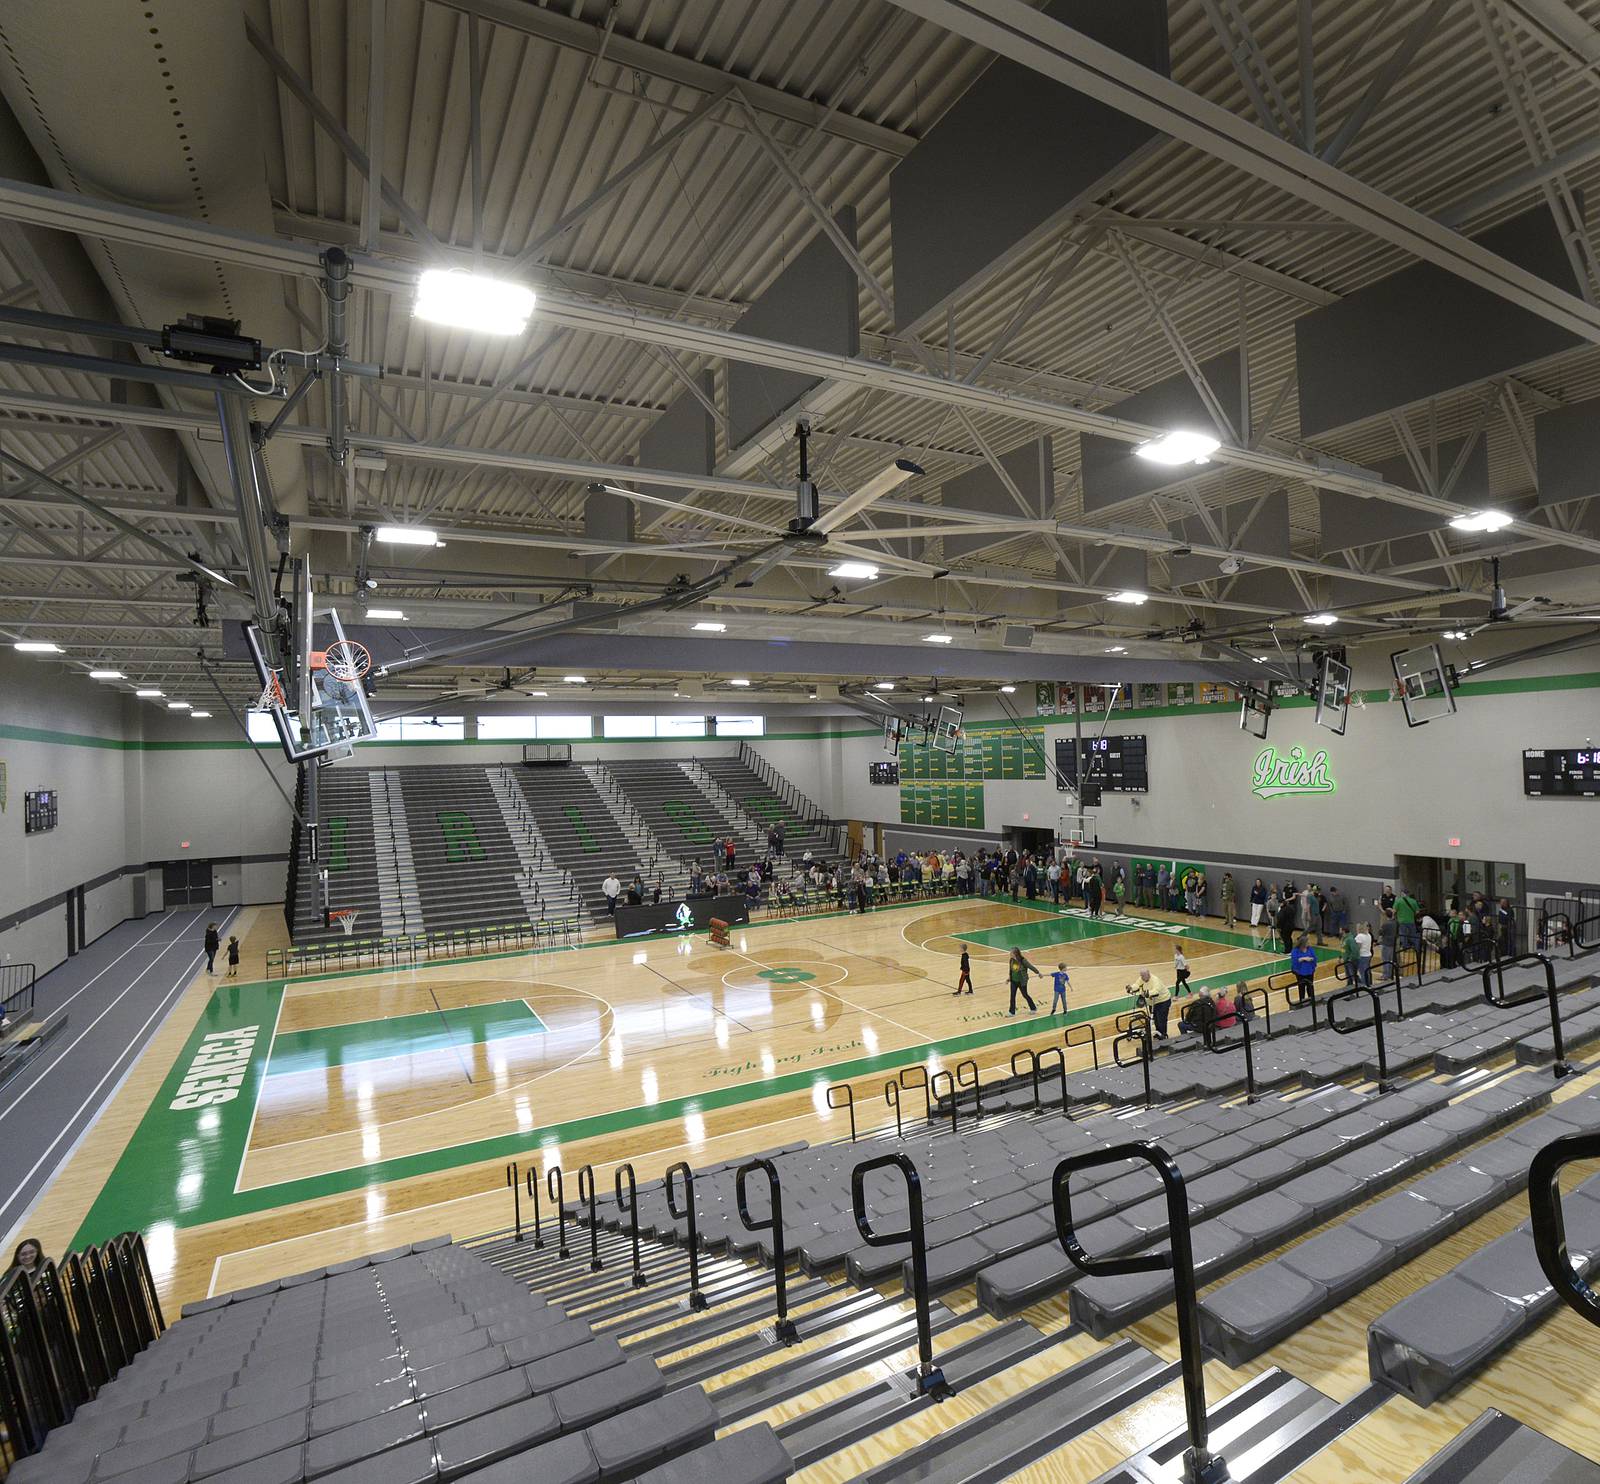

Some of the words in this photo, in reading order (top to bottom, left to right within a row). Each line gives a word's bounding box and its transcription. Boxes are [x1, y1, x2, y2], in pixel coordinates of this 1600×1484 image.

[1252, 747, 1334, 795] Irish
[1525, 750, 1545, 758] HOME
[168, 1024, 260, 1111] SENECA
